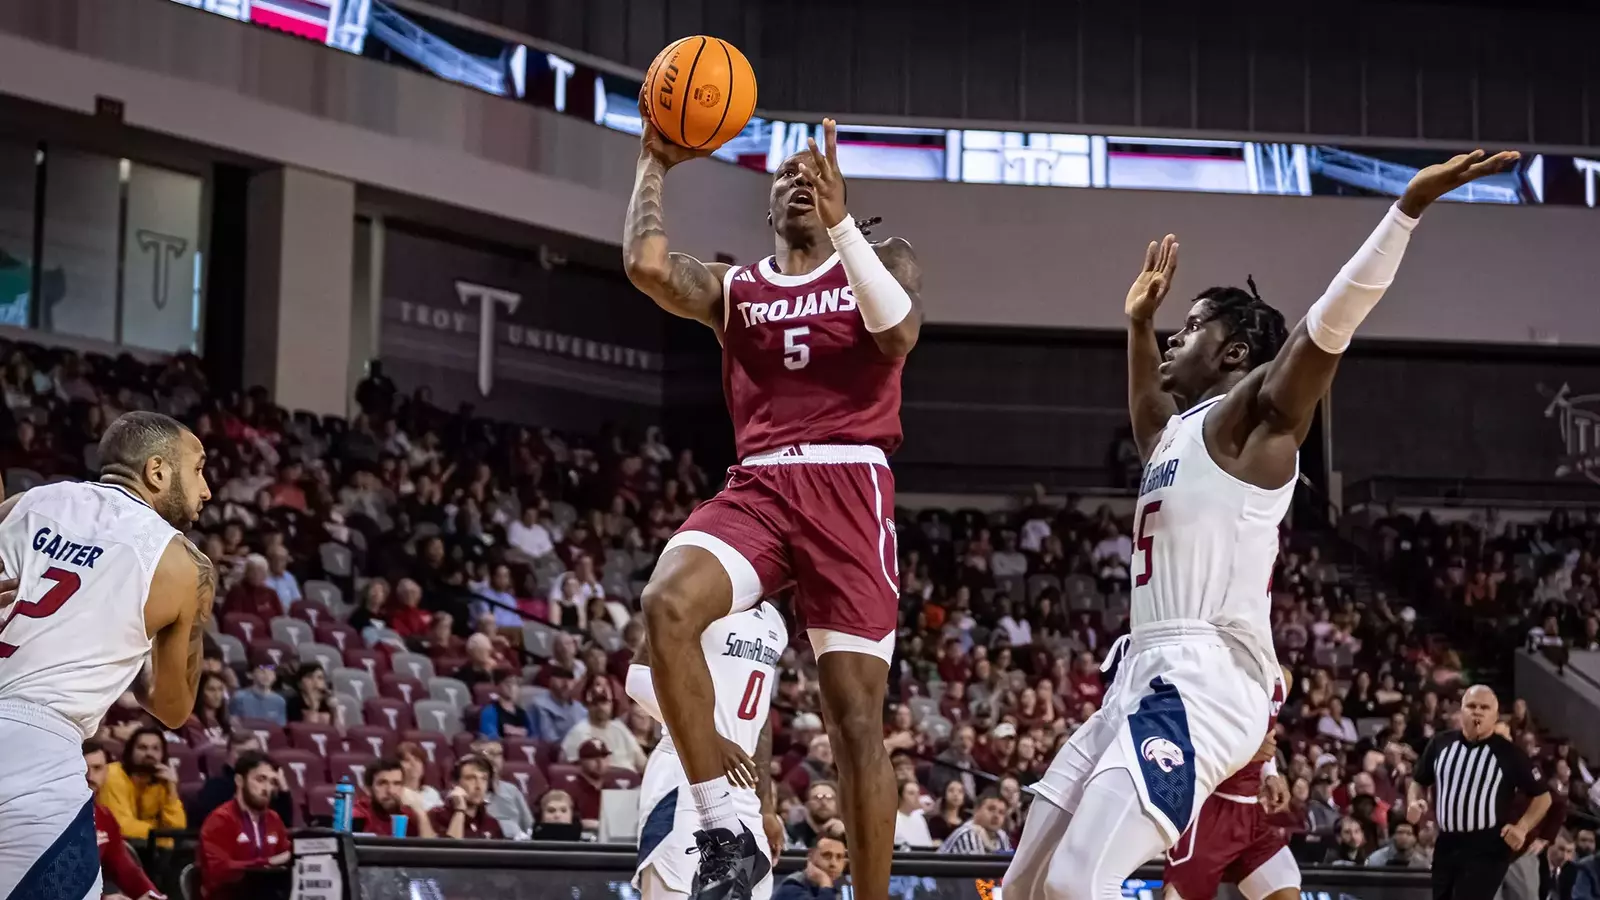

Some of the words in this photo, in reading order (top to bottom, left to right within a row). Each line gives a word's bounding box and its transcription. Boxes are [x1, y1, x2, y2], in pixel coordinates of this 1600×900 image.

[736, 285, 858, 328] TROJANS
[401, 301, 467, 332] TROY
[508, 324, 652, 370] UNIVERSITY
[784, 325, 810, 371] 5
[32, 527, 104, 569] GAITER
[0, 566, 82, 658] 2
[737, 670, 766, 721] 0
